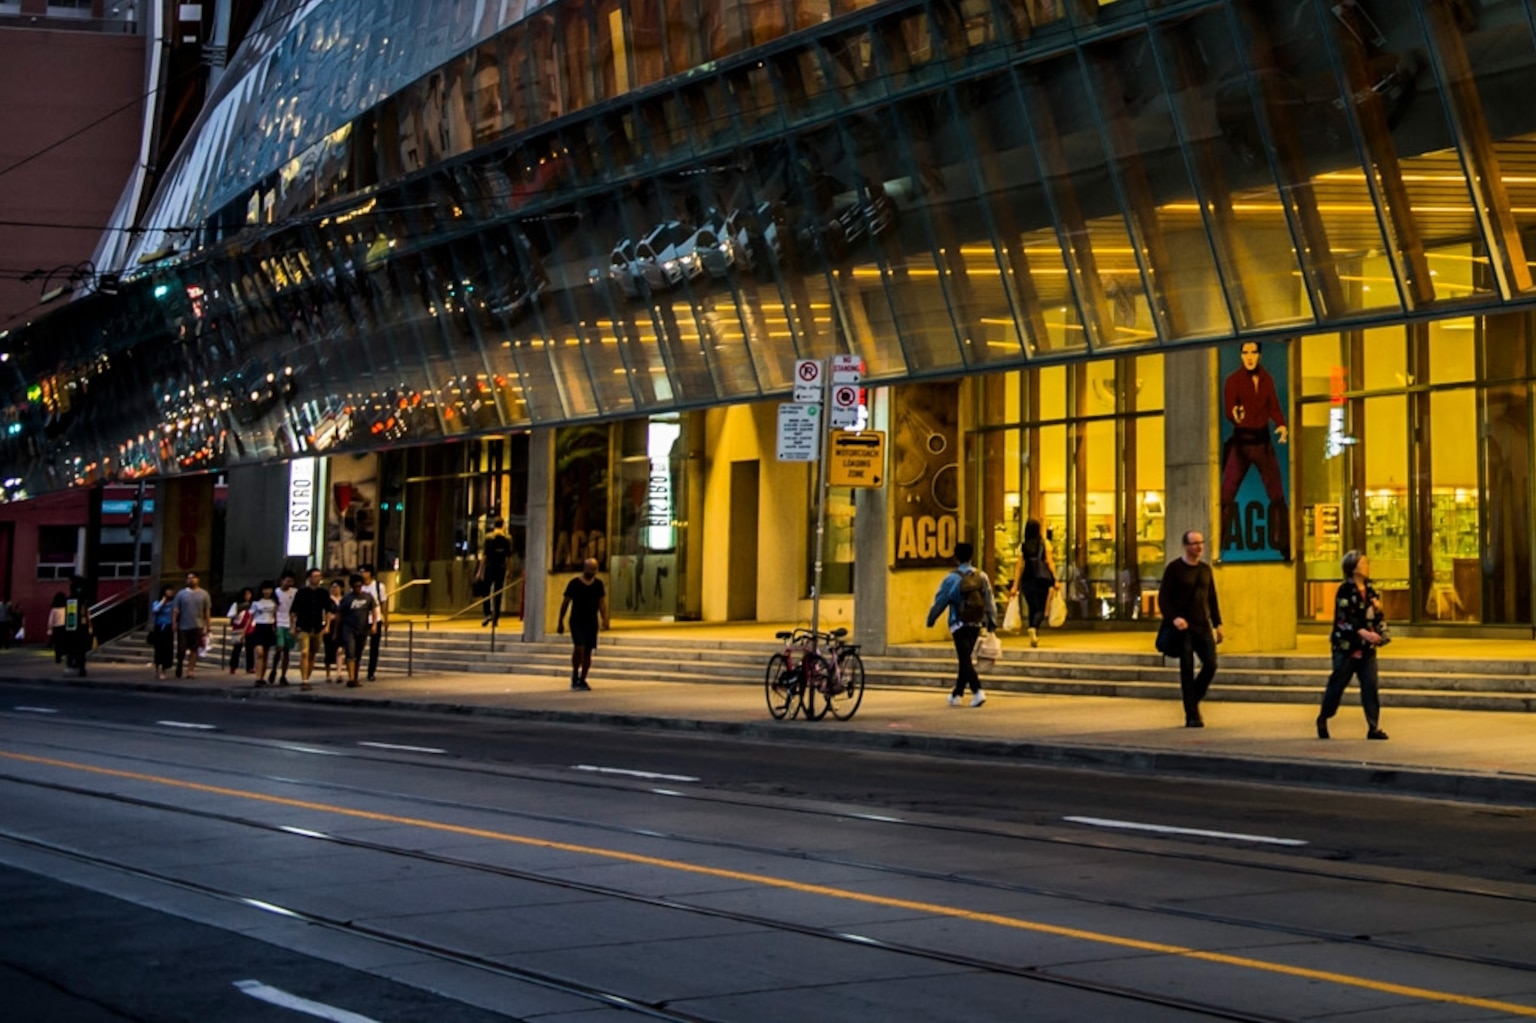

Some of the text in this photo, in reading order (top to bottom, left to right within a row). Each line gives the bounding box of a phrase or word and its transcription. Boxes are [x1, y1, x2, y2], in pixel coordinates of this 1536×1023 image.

[291, 479, 311, 532] BISTRO
[1221, 500, 1288, 551] AGO
[898, 515, 956, 559] AGO
